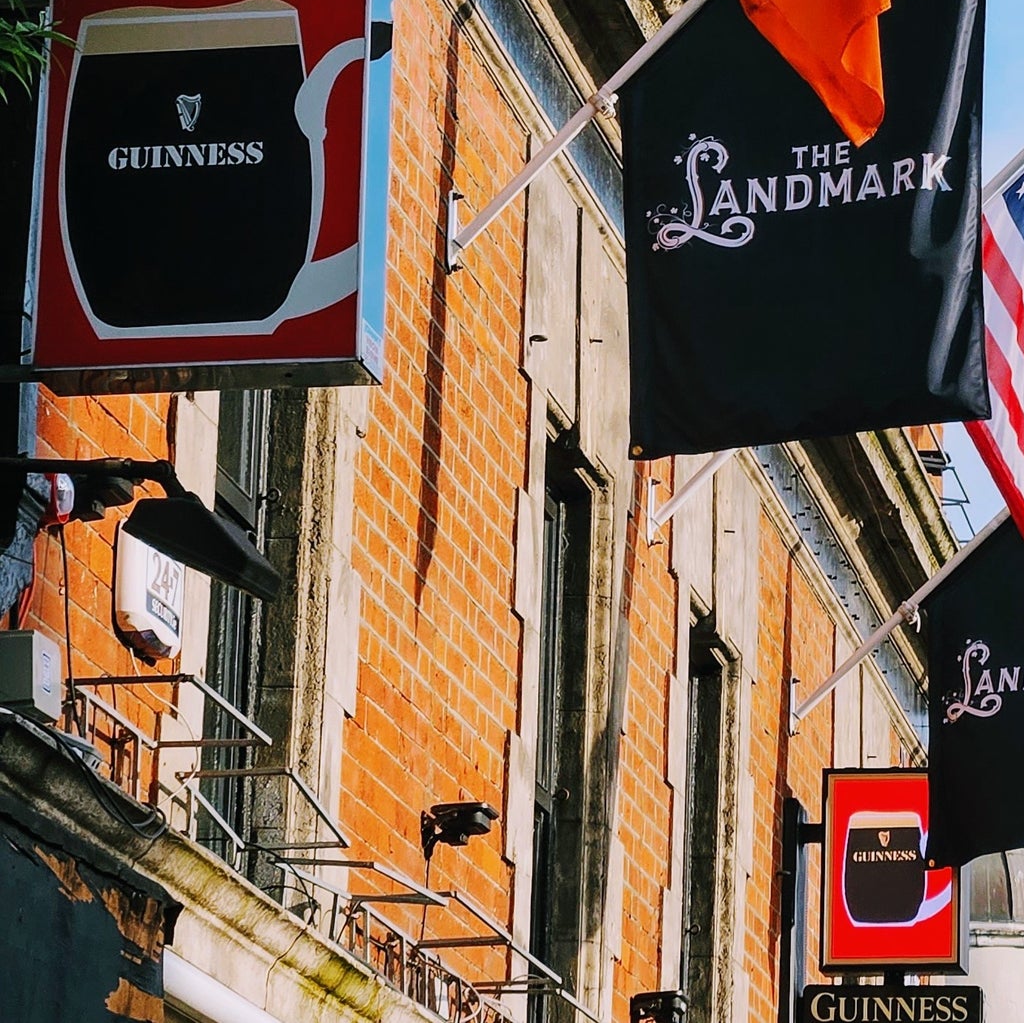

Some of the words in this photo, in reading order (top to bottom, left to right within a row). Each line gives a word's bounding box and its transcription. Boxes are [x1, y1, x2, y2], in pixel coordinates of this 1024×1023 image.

[108, 141, 264, 170] GUINNESS
[791, 140, 850, 169] THE
[647, 133, 953, 251] LANDMARK
[853, 850, 917, 862] GUINNESS
[810, 992, 968, 1022] GUINNESS
